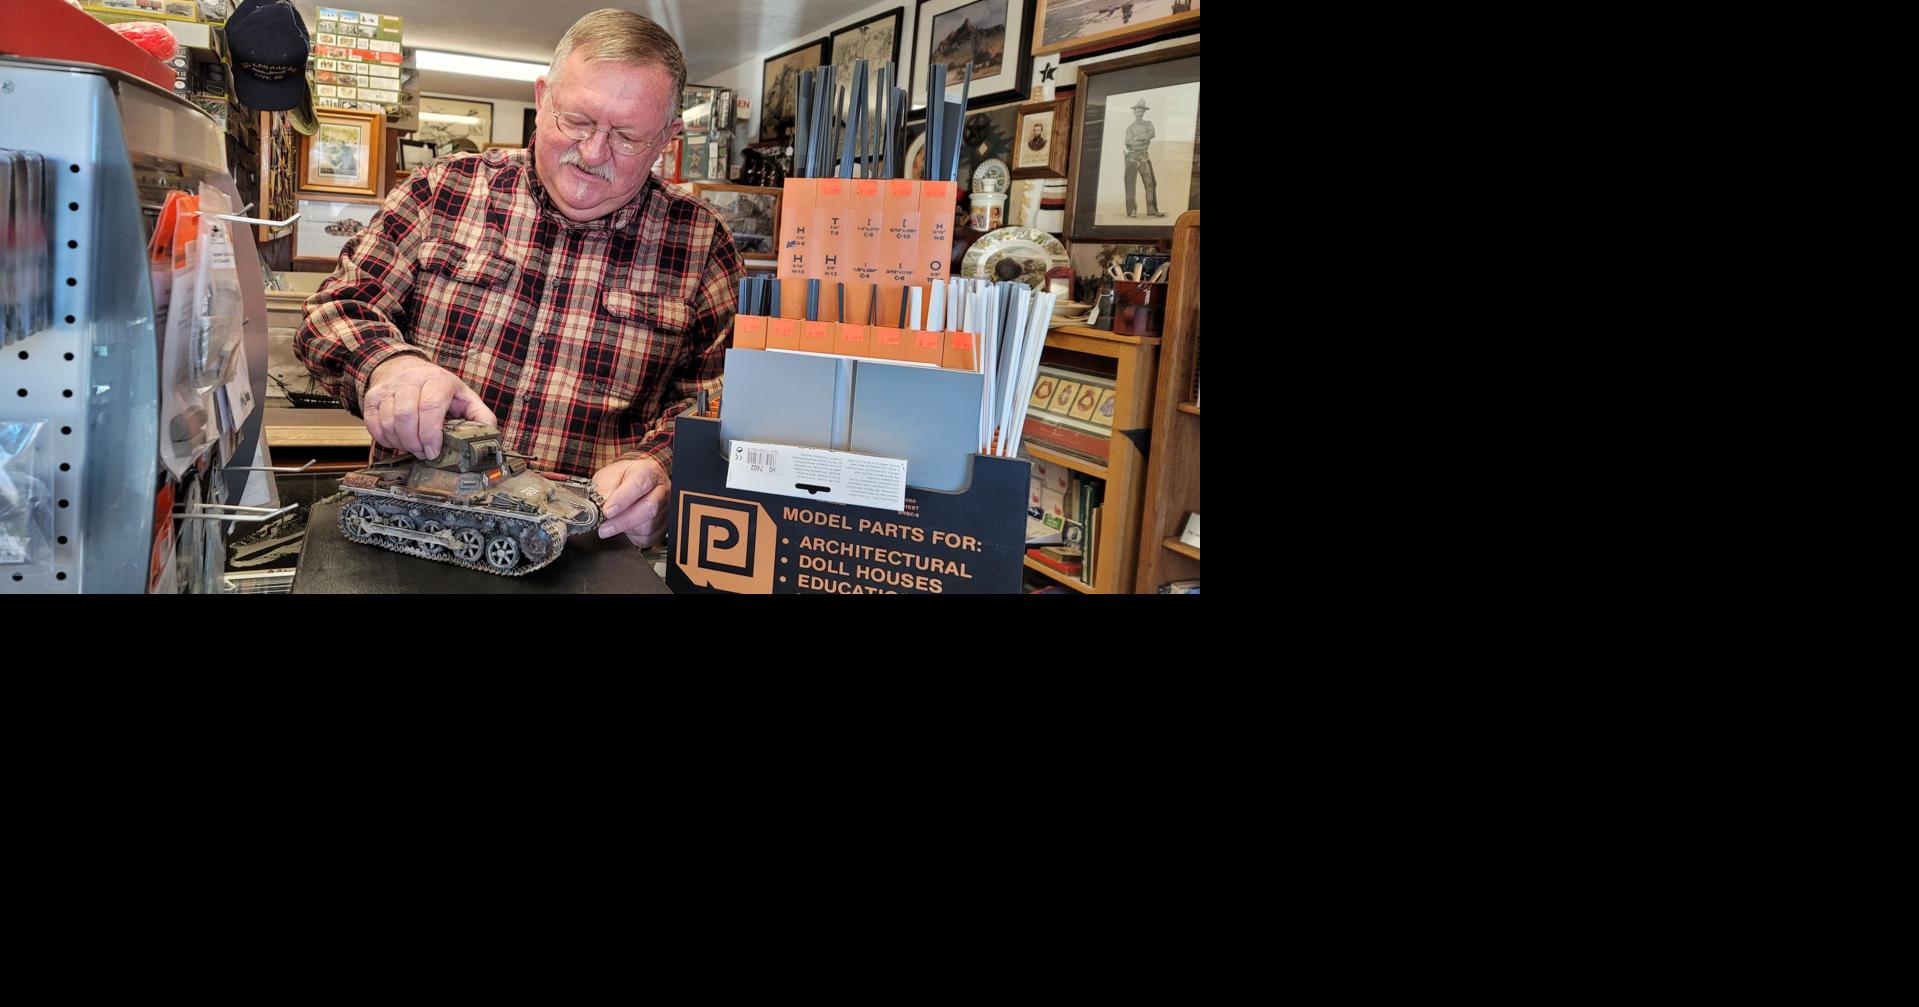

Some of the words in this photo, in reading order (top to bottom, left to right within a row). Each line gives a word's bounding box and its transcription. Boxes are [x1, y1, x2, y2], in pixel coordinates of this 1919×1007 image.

[783, 506, 852, 531] MODEL
[858, 518, 925, 543] PARTS
[932, 530, 982, 553] FOR:
[799, 535, 972, 579] ARCHITECTURAL
[799, 554, 850, 576] DOLL
[856, 565, 943, 594] HOUSES
